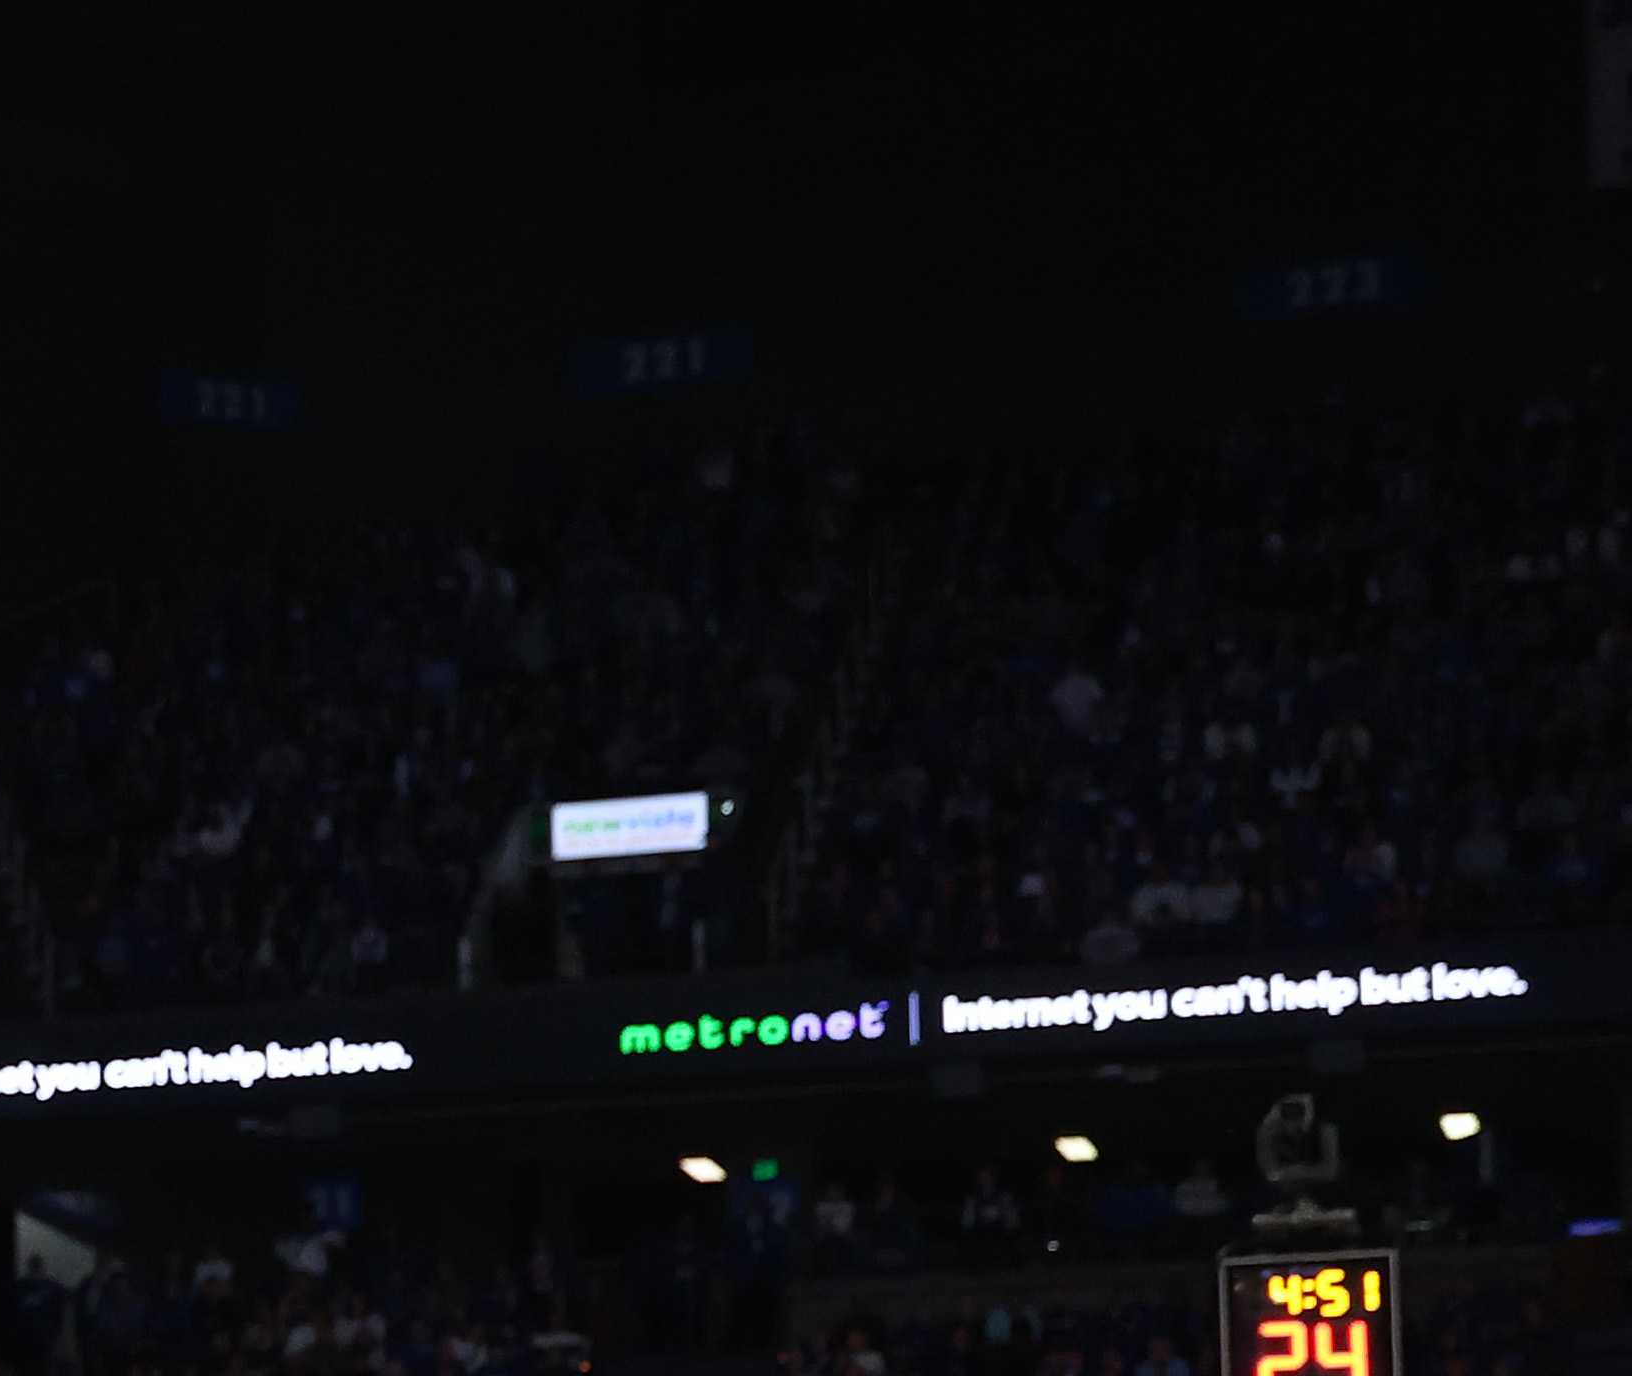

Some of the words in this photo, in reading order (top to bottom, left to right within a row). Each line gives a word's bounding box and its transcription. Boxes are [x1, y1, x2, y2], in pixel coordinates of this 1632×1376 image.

[942, 988, 1093, 1034] Internet
[1089, 989, 1172, 1032] you
[1172, 977, 1270, 1021] can't
[1269, 969, 1356, 1017] help
[1358, 968, 1430, 1008] but
[1431, 960, 1529, 1002] love.
[619, 1000, 888, 1054] metronet
[33, 1061, 101, 1101] you
[1268, 1268, 1381, 1317] 4:51
